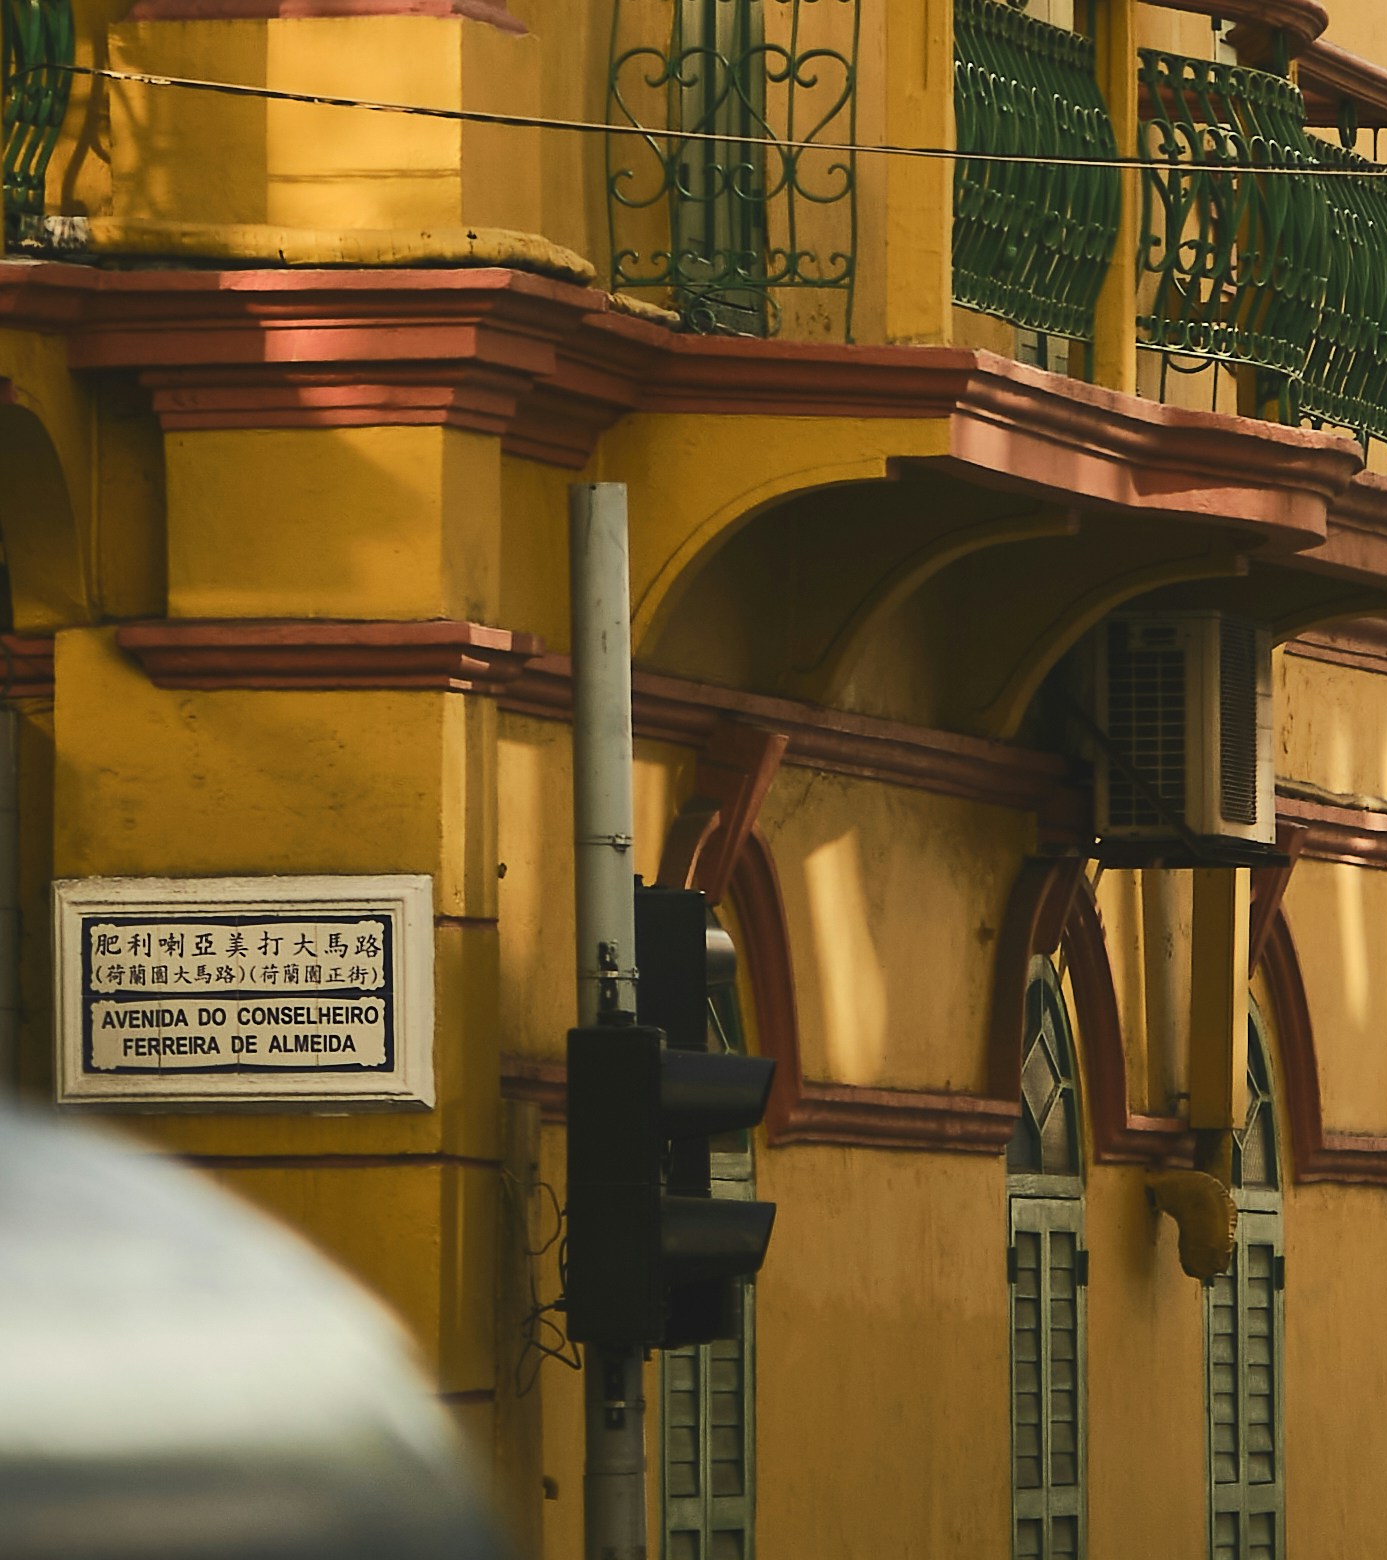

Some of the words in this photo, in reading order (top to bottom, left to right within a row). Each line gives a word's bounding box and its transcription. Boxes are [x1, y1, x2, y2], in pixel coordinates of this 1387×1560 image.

[95, 931, 382, 958] 肥利喇亞美打大馬路
[101, 1008, 189, 1029] AVENIDA
[199, 1008, 227, 1027] DO
[237, 1006, 380, 1026] CONSELHEIRO
[122, 1037, 220, 1057] FERREIRA
[231, 1035, 258, 1054] DE
[268, 1034, 356, 1054] ALMEIDA
